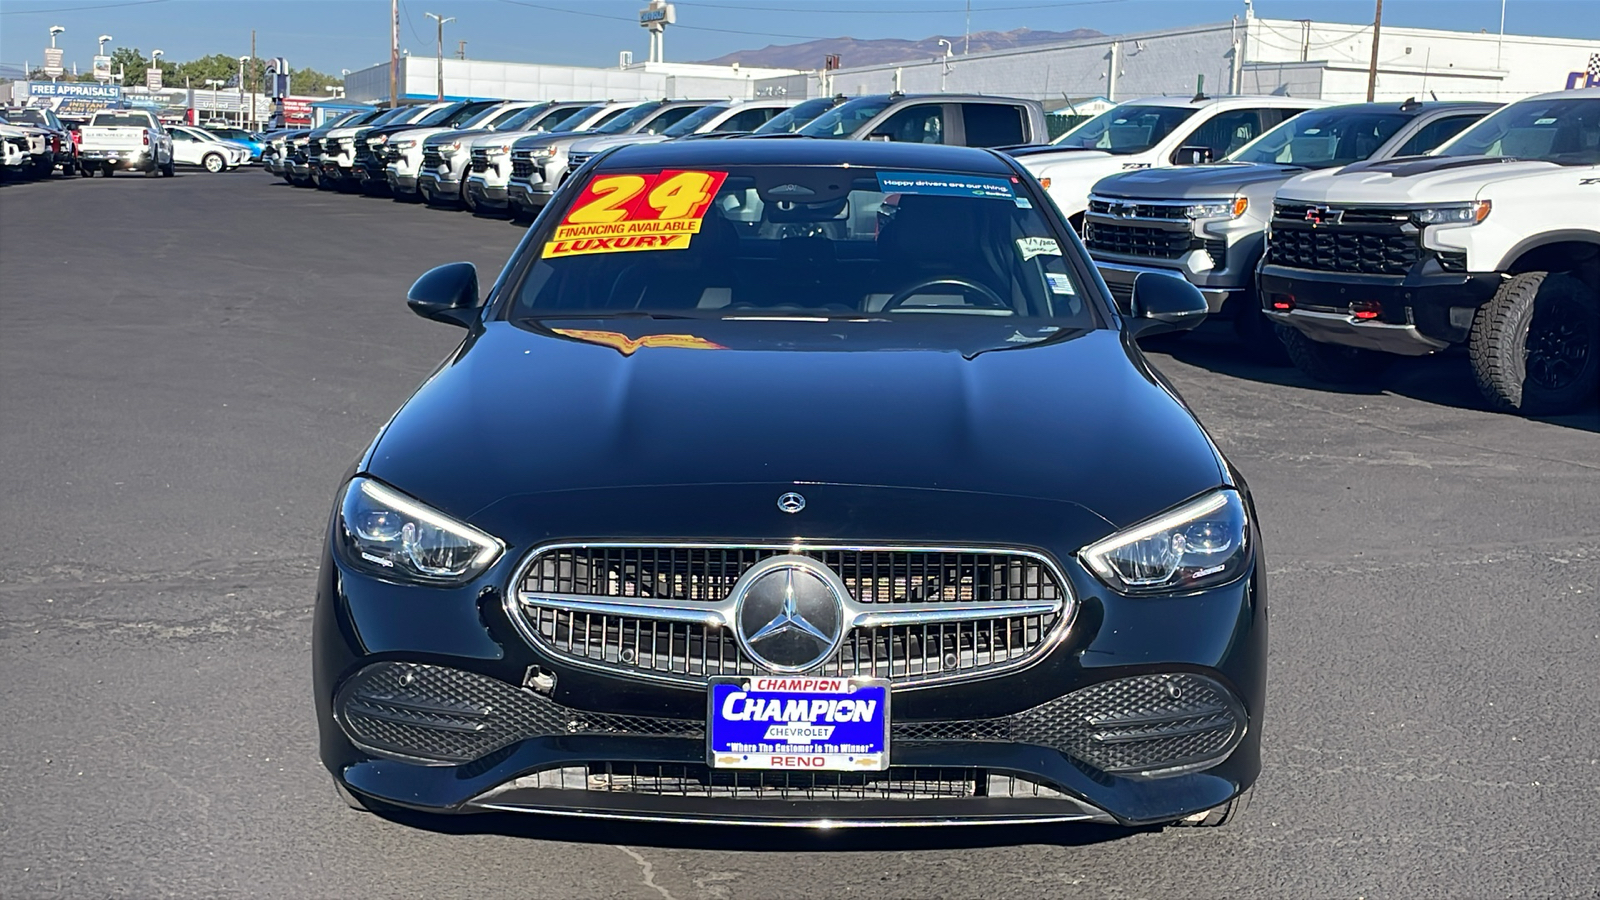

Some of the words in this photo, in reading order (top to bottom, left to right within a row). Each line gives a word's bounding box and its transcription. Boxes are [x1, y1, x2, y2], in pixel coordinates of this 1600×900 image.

[31, 84, 56, 94] FREE
[69, 101, 109, 109] INSTANT
[567, 171, 715, 224] 24
[558, 223, 625, 238] FINANCING
[629, 220, 697, 233] AVAILABLE
[551, 234, 683, 254] LUXURY
[757, 679, 842, 692] CHAMPION
[722, 691, 877, 723] CHAMPION
[769, 728, 829, 737] CHEVROLET
[759, 743, 773, 753] The
[775, 743, 814, 753] Customer
[824, 743, 839, 753] The
[770, 756, 826, 767] RENO
